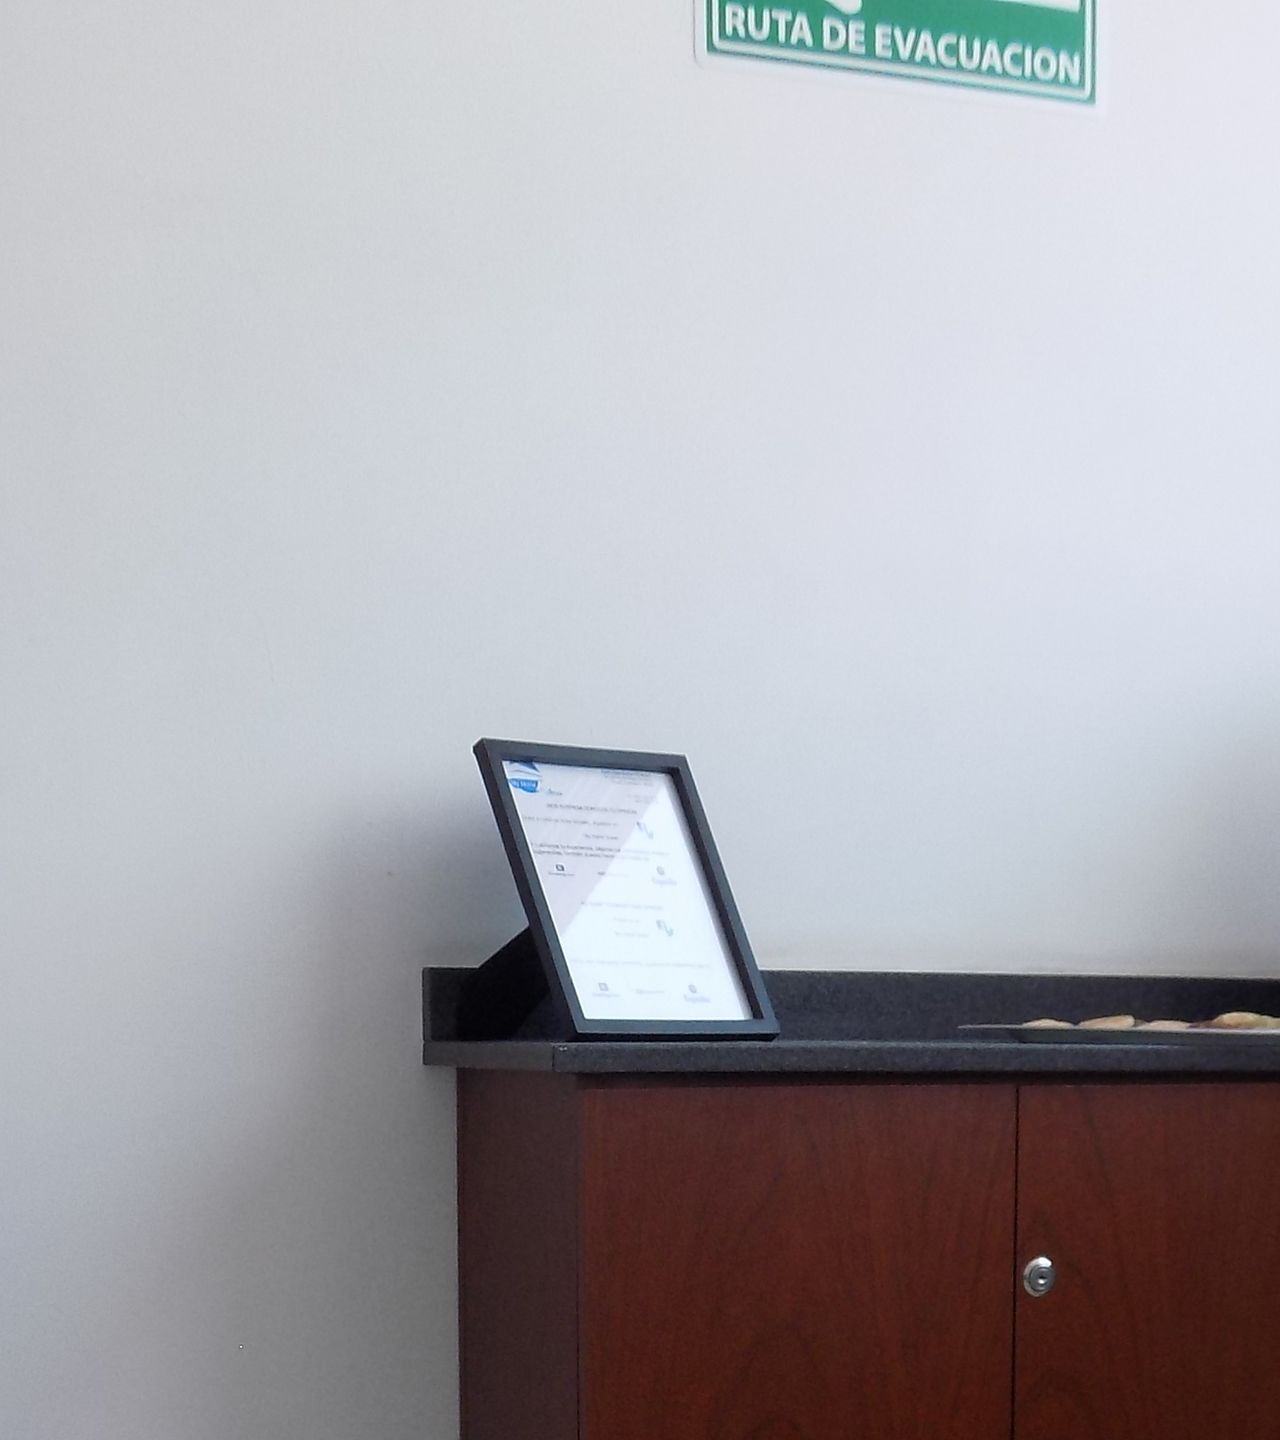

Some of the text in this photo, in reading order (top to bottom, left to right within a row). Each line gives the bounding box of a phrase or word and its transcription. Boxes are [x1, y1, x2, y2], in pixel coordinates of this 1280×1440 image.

[724, 3, 1081, 86] RUTA DE EVACUACION
